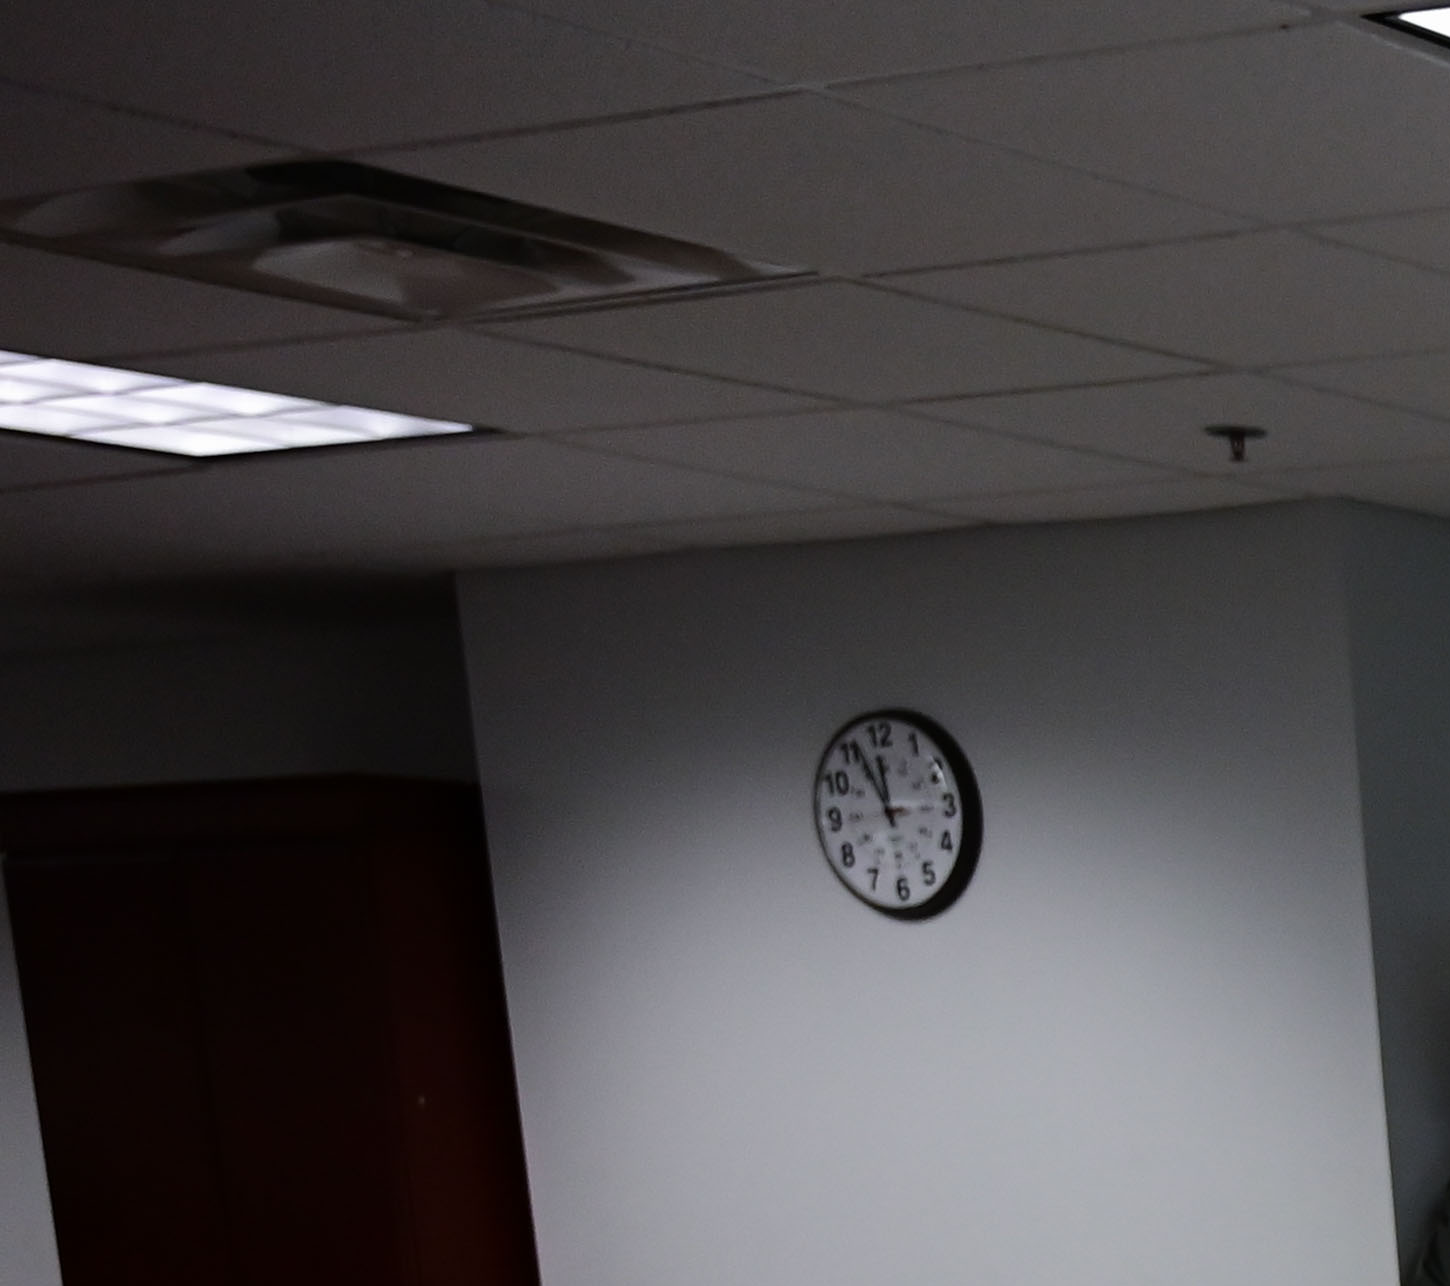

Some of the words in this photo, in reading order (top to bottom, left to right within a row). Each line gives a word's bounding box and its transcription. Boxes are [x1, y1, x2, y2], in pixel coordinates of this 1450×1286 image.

[867, 722, 893, 748] 12
[909, 731, 920, 757] 1
[841, 741, 860, 765] 11
[824, 771, 850, 796] 10
[942, 792, 956, 818] 3
[828, 807, 842, 832] 9
[940, 831, 953, 851] 4
[841, 843, 855, 868] 8
[866, 868, 879, 891] 7
[922, 861, 936, 886] 5
[897, 877, 910, 901] 6
